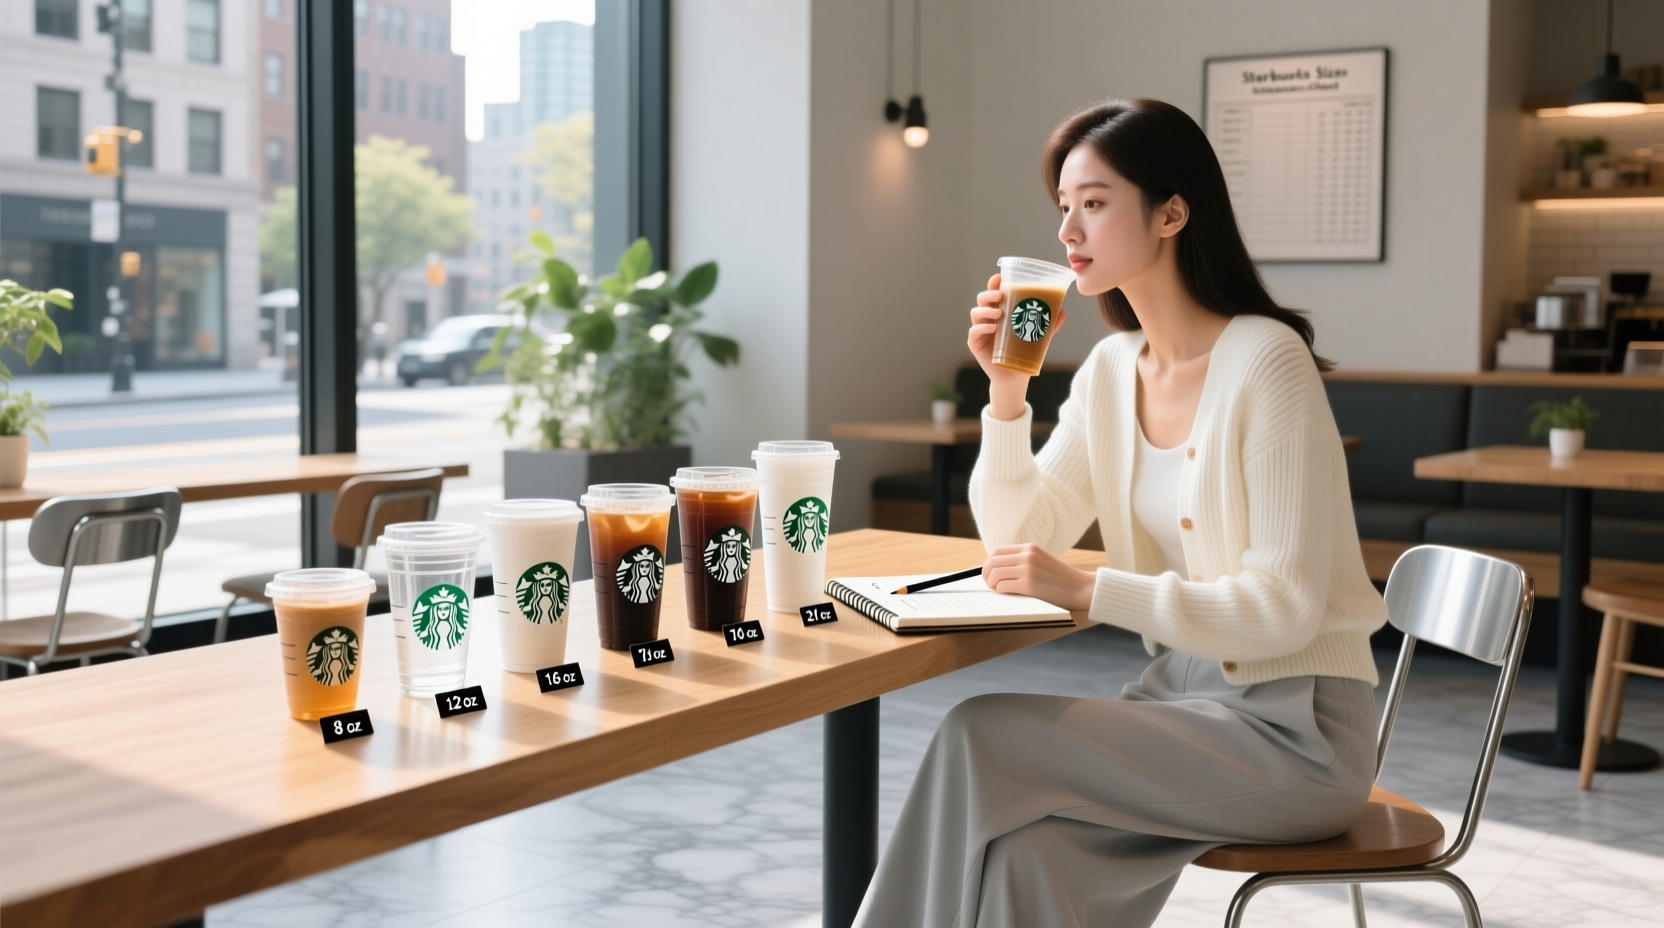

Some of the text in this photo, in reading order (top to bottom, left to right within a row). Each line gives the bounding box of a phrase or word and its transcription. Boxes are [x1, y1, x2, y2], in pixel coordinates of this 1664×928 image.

[653, 649, 667, 659] oz
[545, 671, 576, 685] 16 oz
[446, 695, 478, 711] 12 oz
[333, 720, 363, 735] 8 oz
